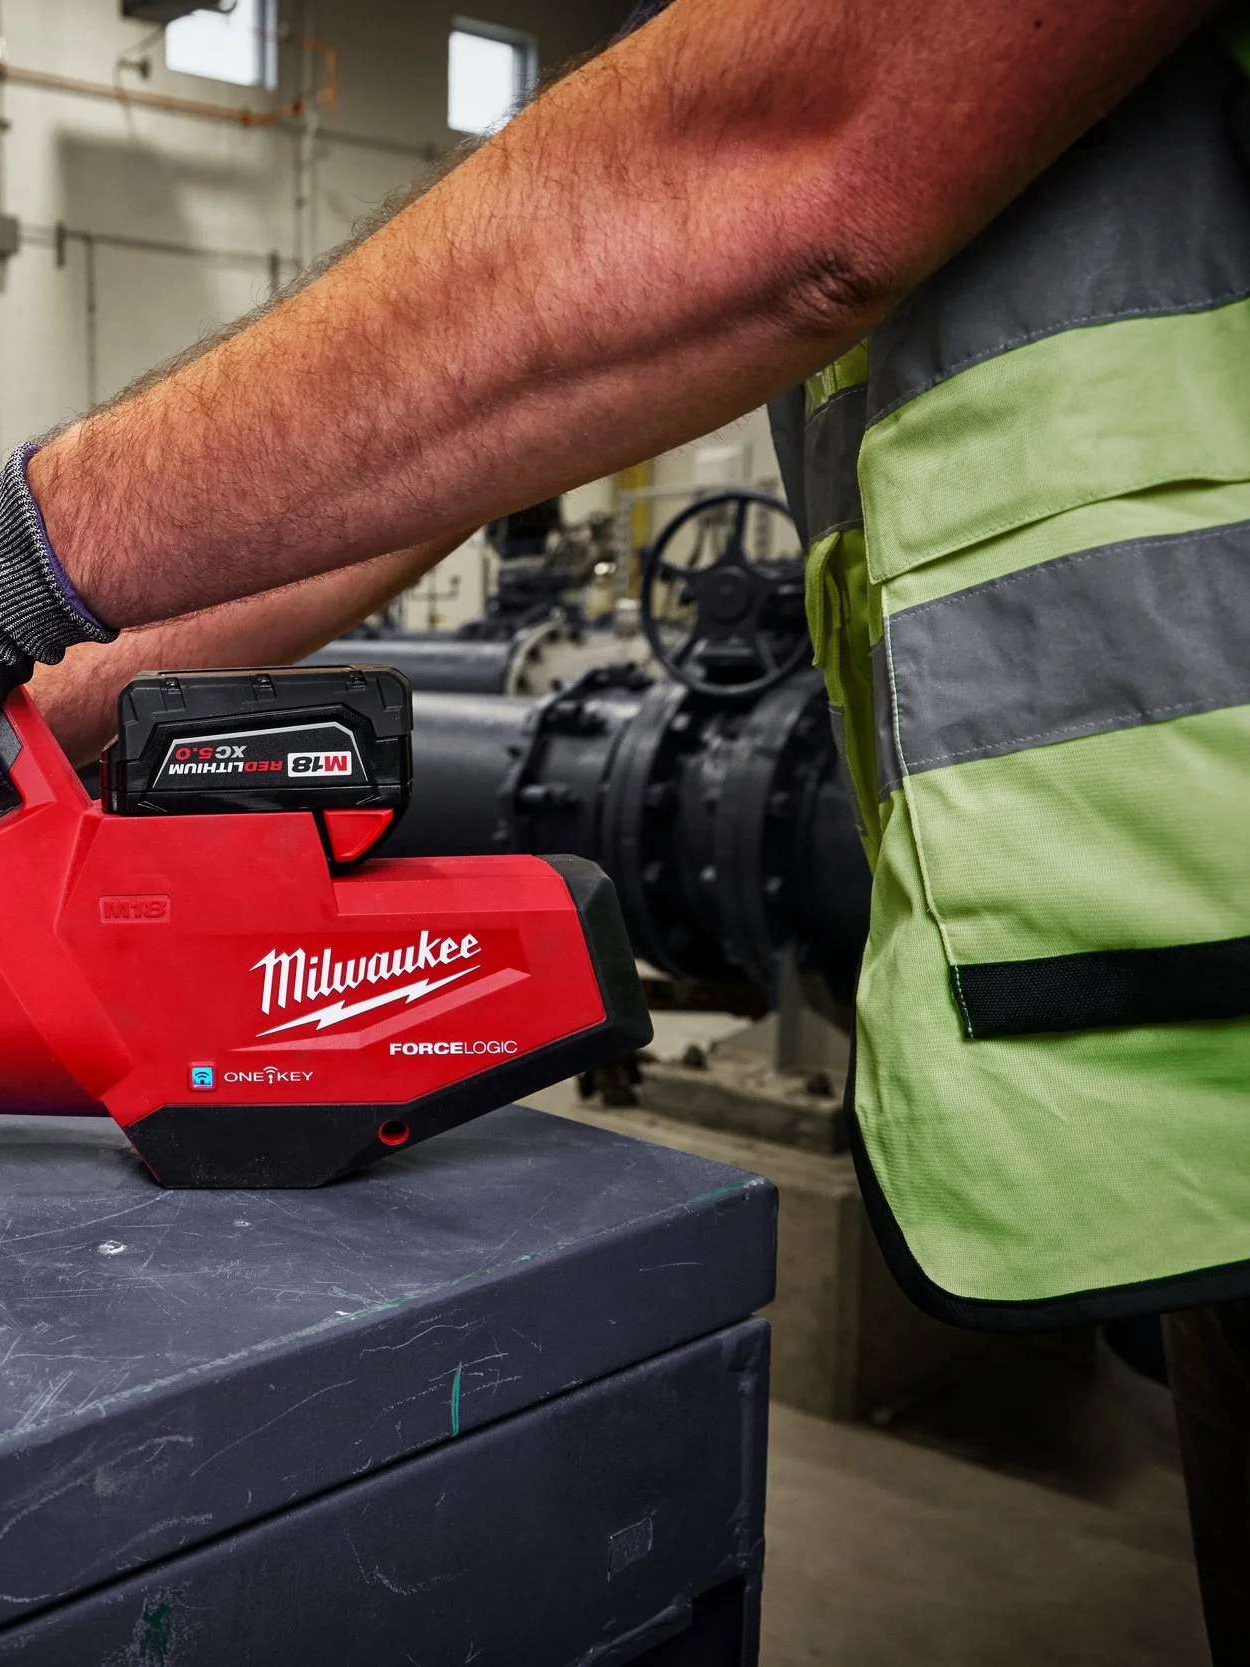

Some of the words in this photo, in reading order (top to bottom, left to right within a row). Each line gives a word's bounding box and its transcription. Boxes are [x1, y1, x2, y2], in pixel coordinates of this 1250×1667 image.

[168, 760, 283, 775] REDLITHIUM
[292, 755, 348, 774] M18
[104, 900, 166, 919] M18
[250, 930, 482, 1015] Milwaukee
[389, 1040, 518, 1055] FORCELOGIC
